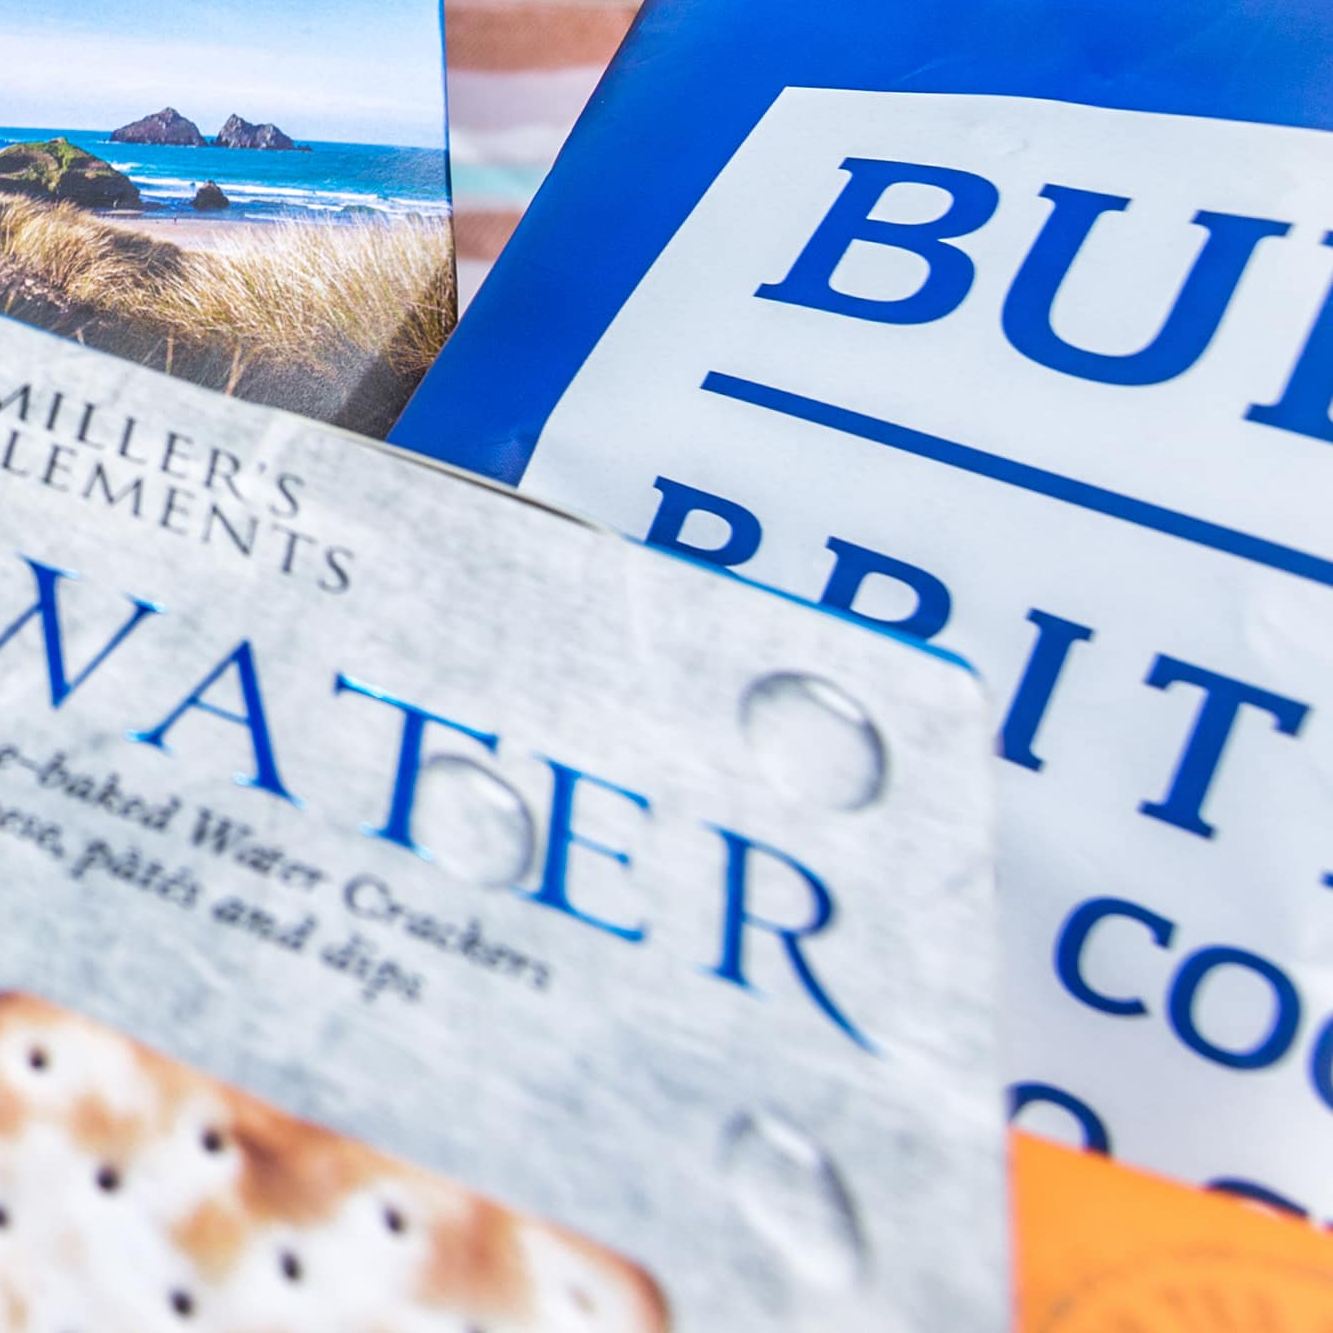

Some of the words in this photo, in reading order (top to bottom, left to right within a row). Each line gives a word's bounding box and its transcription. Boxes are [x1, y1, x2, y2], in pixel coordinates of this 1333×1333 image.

[752, 157, 1333, 446] BU
[191, 805, 326, 891] Water
[341, 872, 554, 991] Crackers
[212, 892, 317, 956] and
[320, 928, 423, 1004] dips
[1053, 895, 1333, 1117] CO
